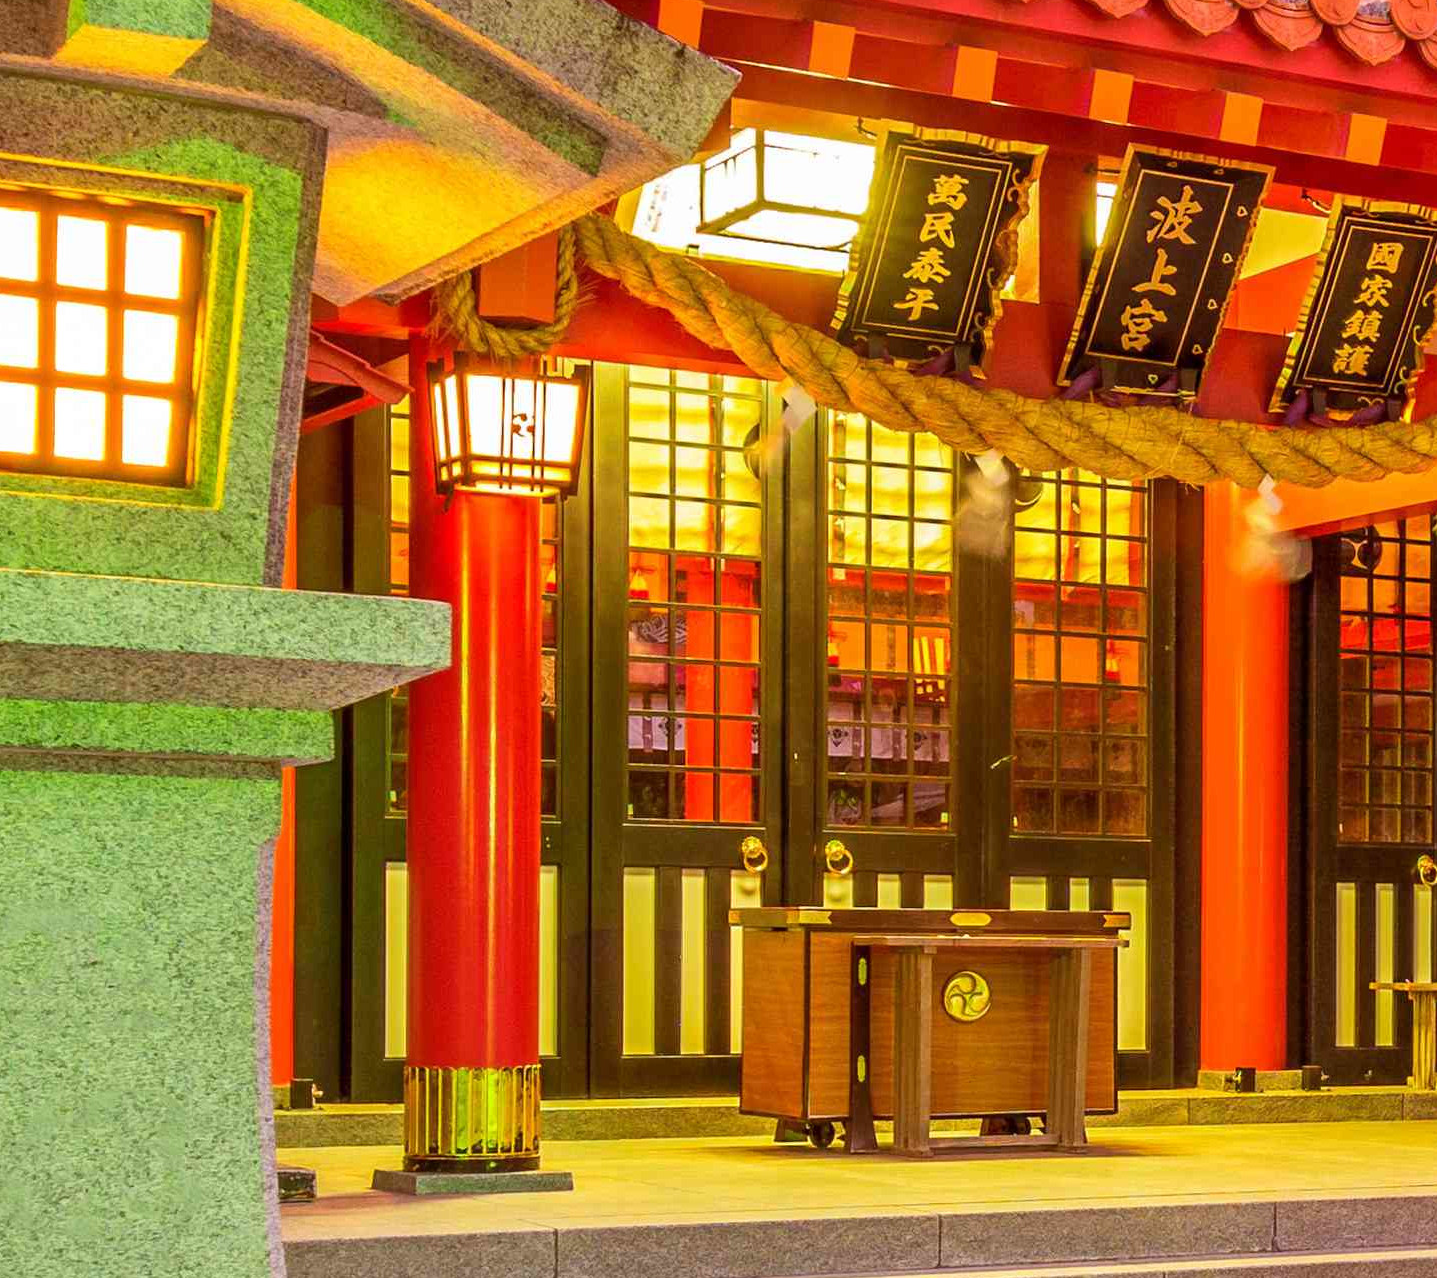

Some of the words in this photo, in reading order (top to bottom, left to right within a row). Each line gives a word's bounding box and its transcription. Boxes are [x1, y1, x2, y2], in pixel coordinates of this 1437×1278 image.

[893, 173, 970, 322] 萬民泰平
[1120, 184, 1204, 352] 波上宮
